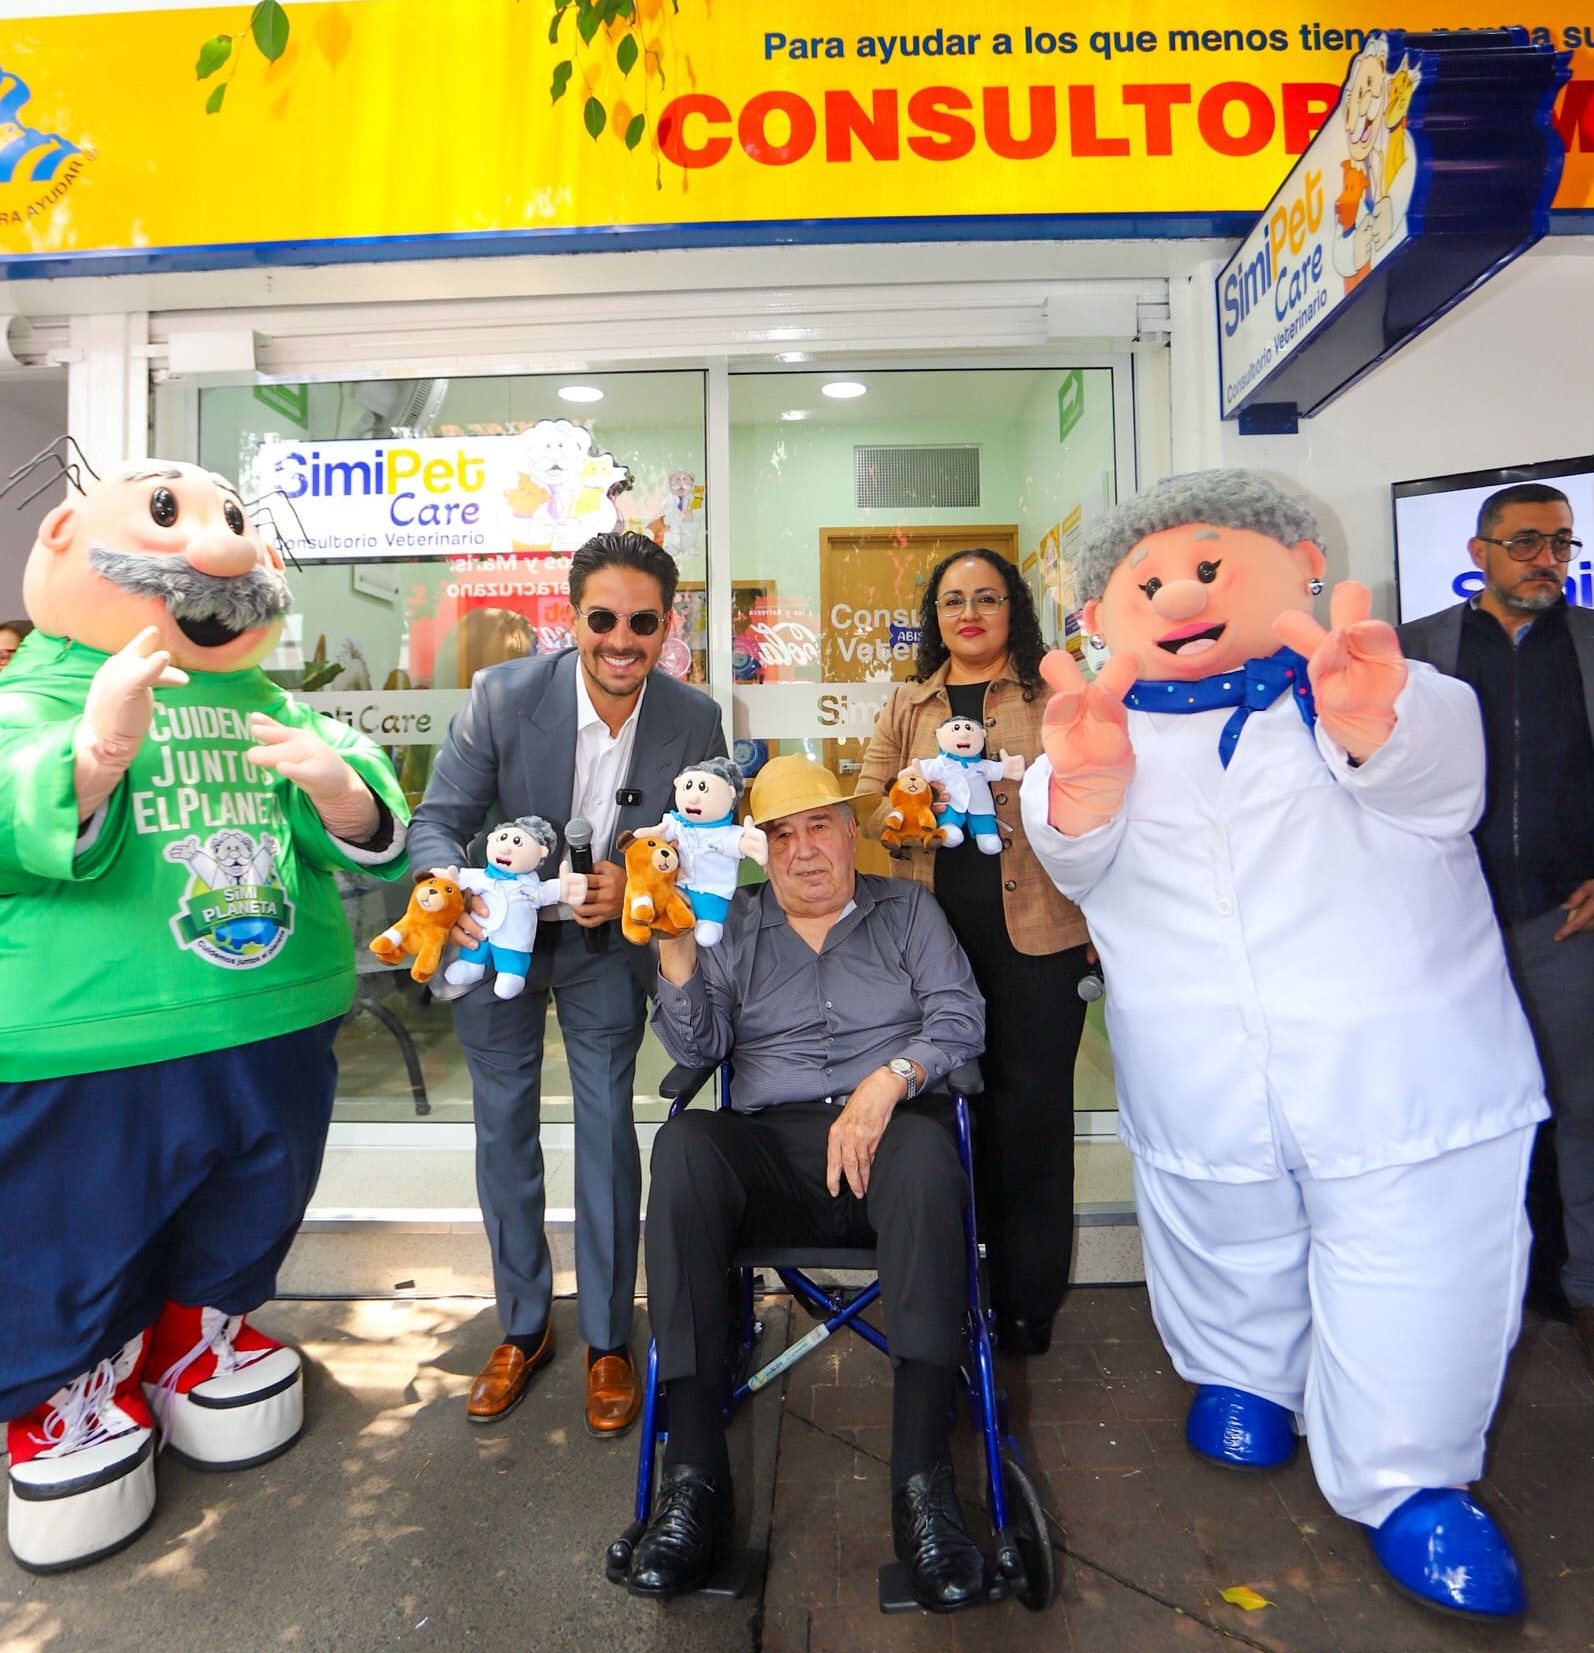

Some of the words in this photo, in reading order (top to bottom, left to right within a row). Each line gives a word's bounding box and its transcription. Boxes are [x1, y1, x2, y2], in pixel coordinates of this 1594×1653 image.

[764, 32, 844, 60] Para
[856, 28, 981, 64] ayudar
[992, 32, 1012, 54] a
[1024, 26, 1078, 54] los
[1089, 30, 1157, 60] que
[1168, 27, 1289, 51] menos
[1298, 22, 1400, 51] tien
[26, 159, 84, 219] AYUDAR
[1224, 168, 1323, 338] SimiPet
[1274, 242, 1323, 322] Care
[1227, 346, 1272, 404] Consultorio
[1273, 288, 1328, 354] Veterinario
[273, 448, 485, 499] SimiPet
[389, 491, 481, 527] Care
[384, 529, 486, 548] Veterinario
[358, 704, 432, 734] Care
[202, 900, 277, 922] PLANETA
